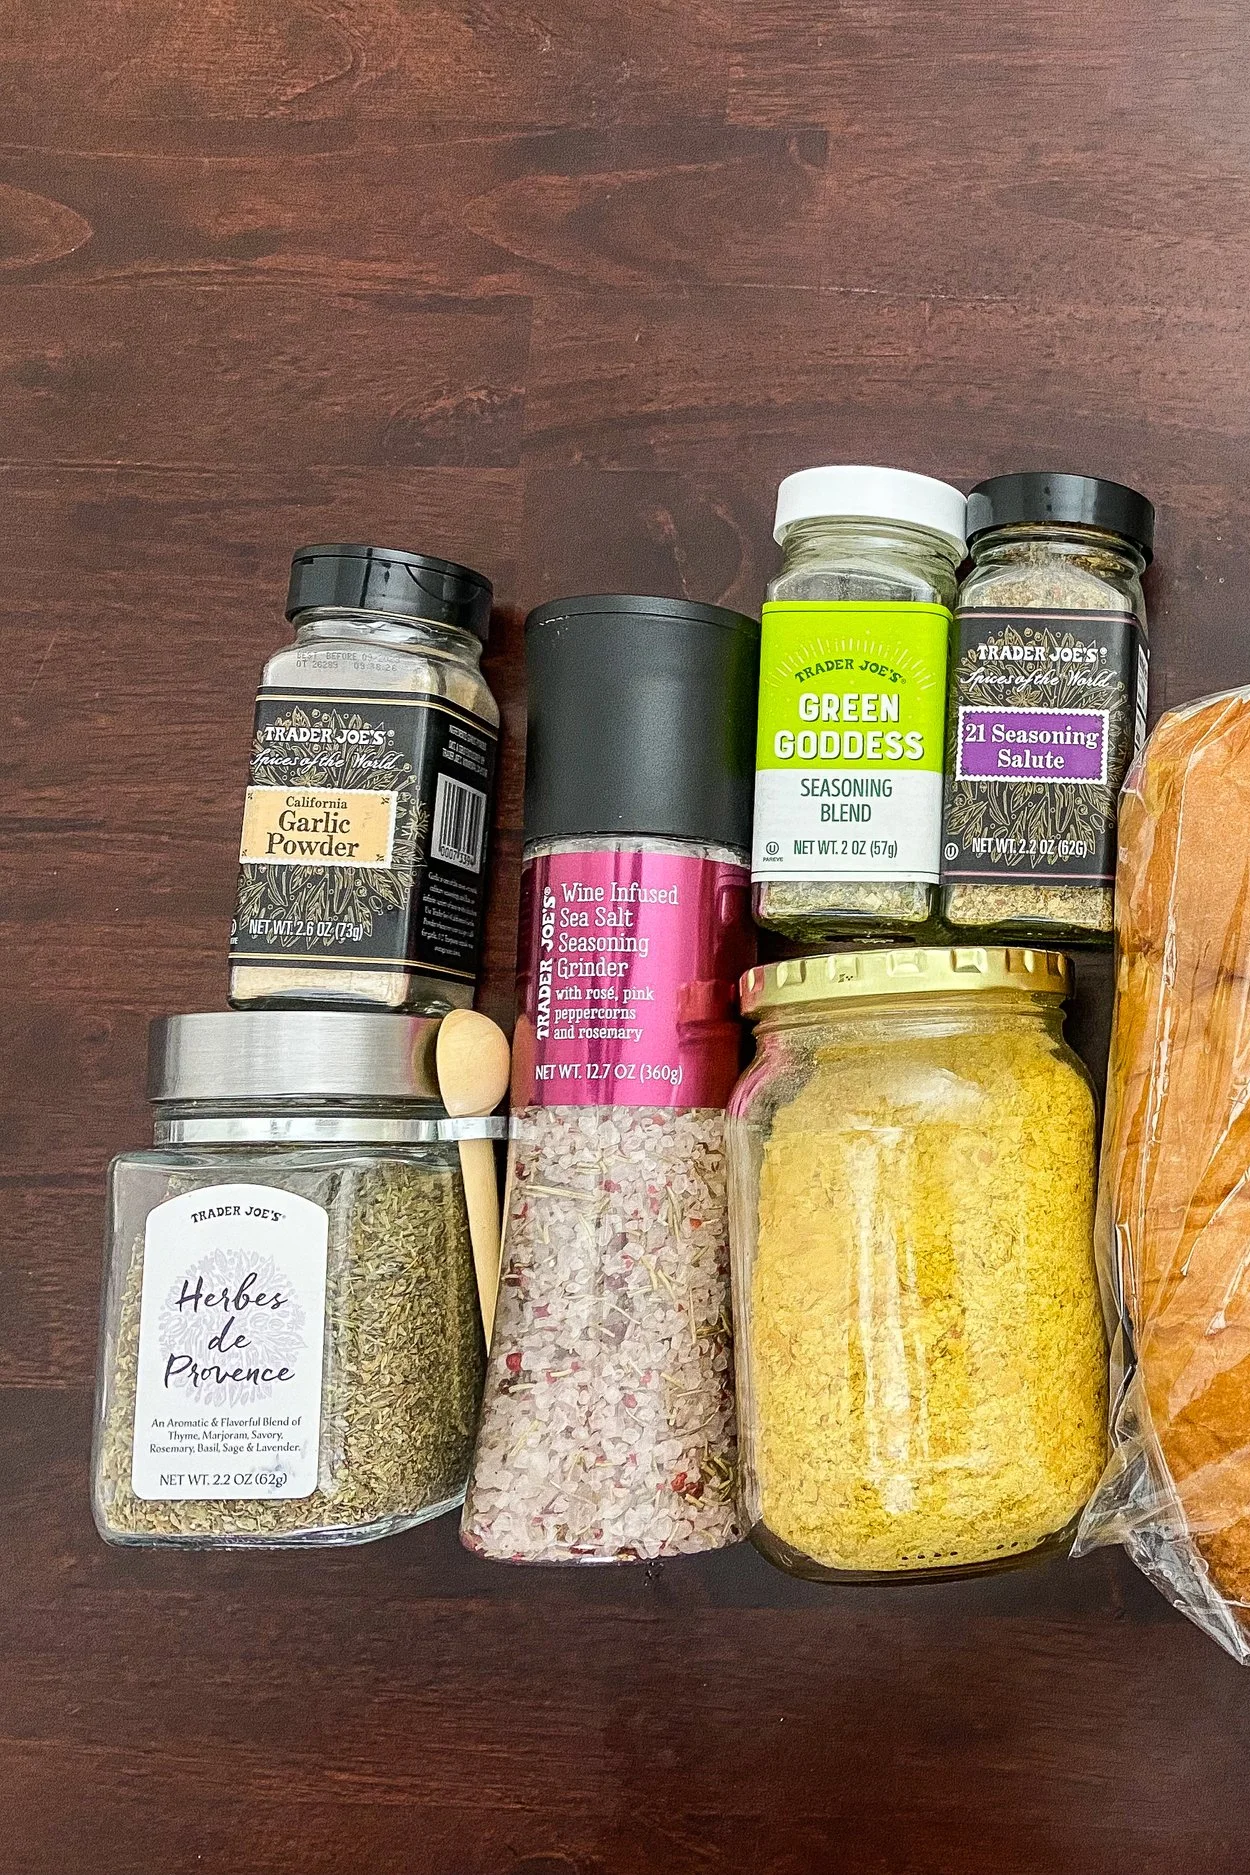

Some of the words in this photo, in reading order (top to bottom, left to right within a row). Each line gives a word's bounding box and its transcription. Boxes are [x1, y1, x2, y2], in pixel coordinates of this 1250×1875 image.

[326, 652, 358, 660] BEFORE
[976, 643, 1046, 662] TRADER
[1048, 647, 1099, 663] JOE'S
[794, 658, 854, 683] TRADER
[859, 659, 903, 684] JOE'S
[960, 668, 1016, 692] Spices
[1068, 671, 1118, 688] World
[798, 693, 900, 723] GREEN
[264, 726, 334, 744] TRADER
[335, 729, 386, 746] JOE'S
[774, 730, 925, 761] GODDESS
[964, 723, 986, 743] 21
[991, 724, 1100, 750] Seasoning
[250, 748, 298, 774] Spices
[352, 751, 404, 771] World
[997, 748, 1065, 770] Salute
[800, 778, 893, 798] SEASONING
[286, 796, 348, 810] California
[820, 803, 872, 822] BLEND
[278, 809, 351, 834] Garlic
[264, 832, 360, 858] Powder
[794, 840, 815, 855] NET
[818, 840, 838, 856] WT.
[852, 840, 866, 856] OZ
[870, 840, 898, 858] (57g)
[972, 837, 994, 854] NET
[996, 838, 1017, 854] WT.
[1018, 838, 1038, 854] 2.2
[1039, 839, 1055, 855] OZ
[1058, 840, 1088, 858] (62G)
[560, 882, 605, 903] Wine
[610, 881, 680, 906] Infused
[540, 896, 556, 952] JOE'S
[560, 908, 590, 928] Sea
[594, 906, 634, 928] Salt
[249, 919, 270, 935] NET
[274, 920, 294, 936] WT.
[295, 920, 314, 937] 2.6
[316, 922, 332, 938] OZ
[334, 922, 364, 942] (73g)
[558, 932, 650, 958] Seasoning
[557, 957, 629, 979] Grinder
[536, 958, 554, 1041] TRADER
[556, 986, 582, 1001] with
[585, 986, 618, 1002] rosé,
[622, 986, 654, 1004] pink
[554, 1007, 636, 1024] peppercorns
[553, 1025, 575, 1040] and
[578, 1026, 643, 1042] rosemary
[535, 1065, 556, 1080] NET
[559, 1064, 582, 1080] WT.
[586, 1064, 610, 1079] 12.7
[614, 1064, 636, 1080] OZ
[639, 1065, 683, 1085] (360g)
[190, 1205, 240, 1224] TRADER
[244, 1206, 282, 1222] JOE'S
[174, 1272, 288, 1313] Herbes
[208, 1316, 252, 1352] de
[164, 1352, 296, 1388] Provence
[151, 1418, 165, 1428] An
[166, 1418, 209, 1428] Aromatic
[220, 1416, 261, 1428] Flavorful
[262, 1416, 288, 1427] Blend
[292, 1416, 302, 1426] of
[168, 1430, 201, 1441] Thyme,
[251, 1430, 284, 1441] Savory,
[150, 1443, 196, 1456] Rosemary,
[197, 1443, 220, 1452] Basil,
[222, 1444, 244, 1454] Sage
[256, 1443, 301, 1452] Lavender.
[160, 1474, 184, 1486] NET
[187, 1474, 210, 1486] WT.
[212, 1474, 230, 1486] 2.2
[233, 1474, 252, 1486] OZ
[254, 1473, 288, 1488] (62g)
